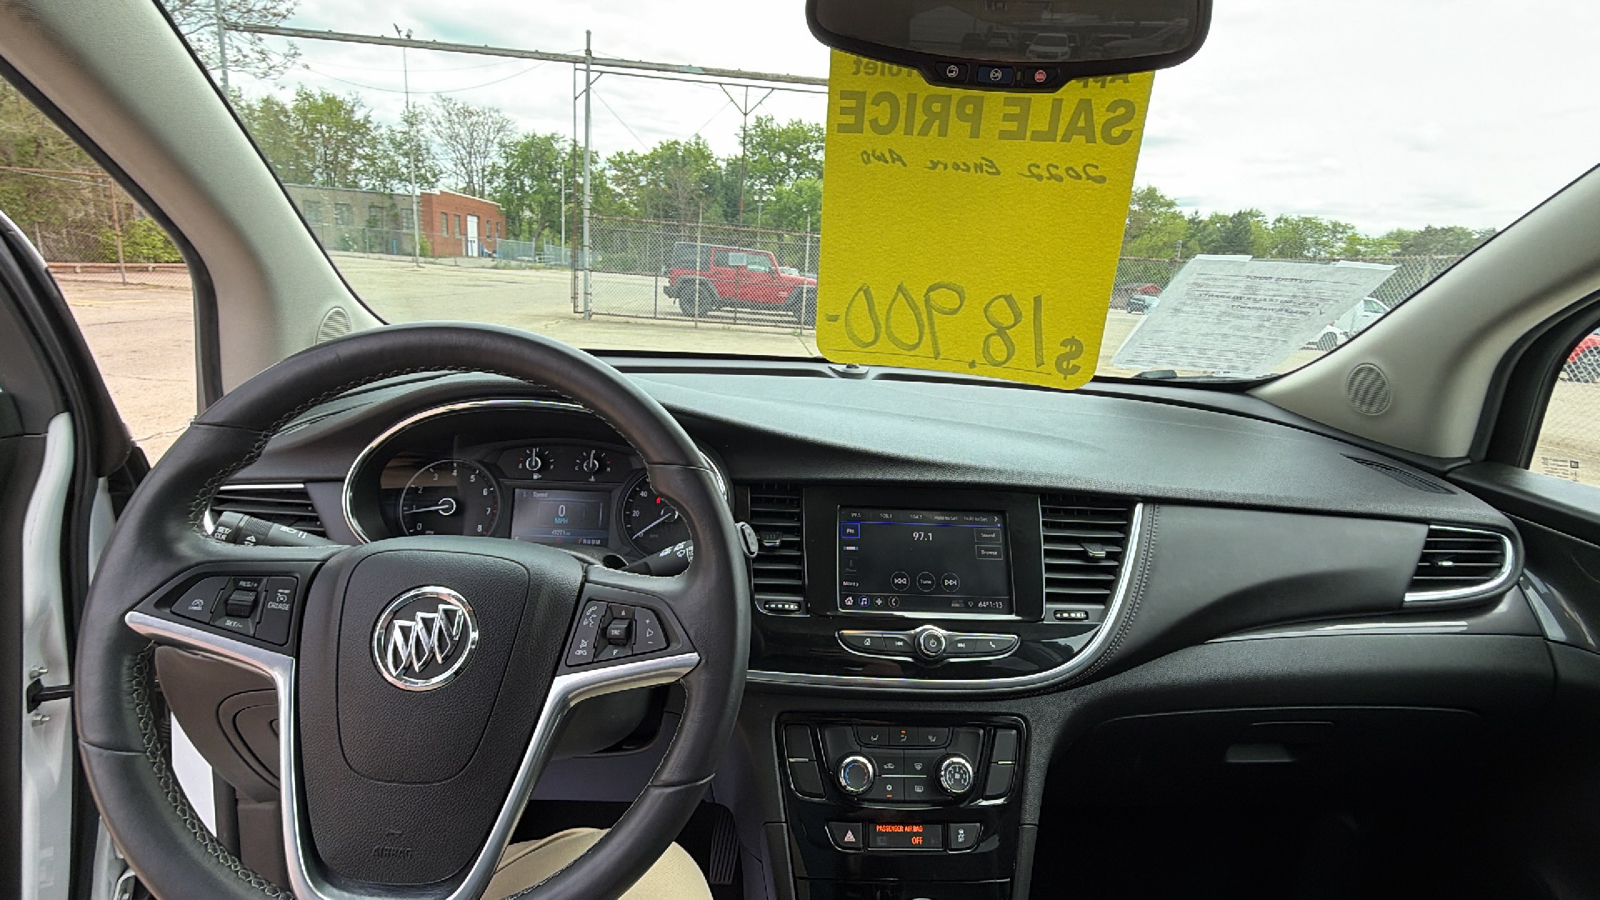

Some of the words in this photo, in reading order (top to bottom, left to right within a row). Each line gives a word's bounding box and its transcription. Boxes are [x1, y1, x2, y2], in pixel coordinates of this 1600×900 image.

[433, 473, 439, 481] 3
[469, 474, 476, 483] 5
[417, 486, 424, 494] 2
[482, 488, 488, 496] 6
[640, 490, 648, 498] 40
[486, 507, 491, 516] 7
[558, 504, 566, 518] 0
[632, 509, 640, 518] 20
[416, 522, 423, 531] 0
[476, 524, 483, 533] 8
[912, 531, 933, 541] 97.1
[876, 825, 904, 833] PASSENGER
[911, 836, 923, 845] OFF
